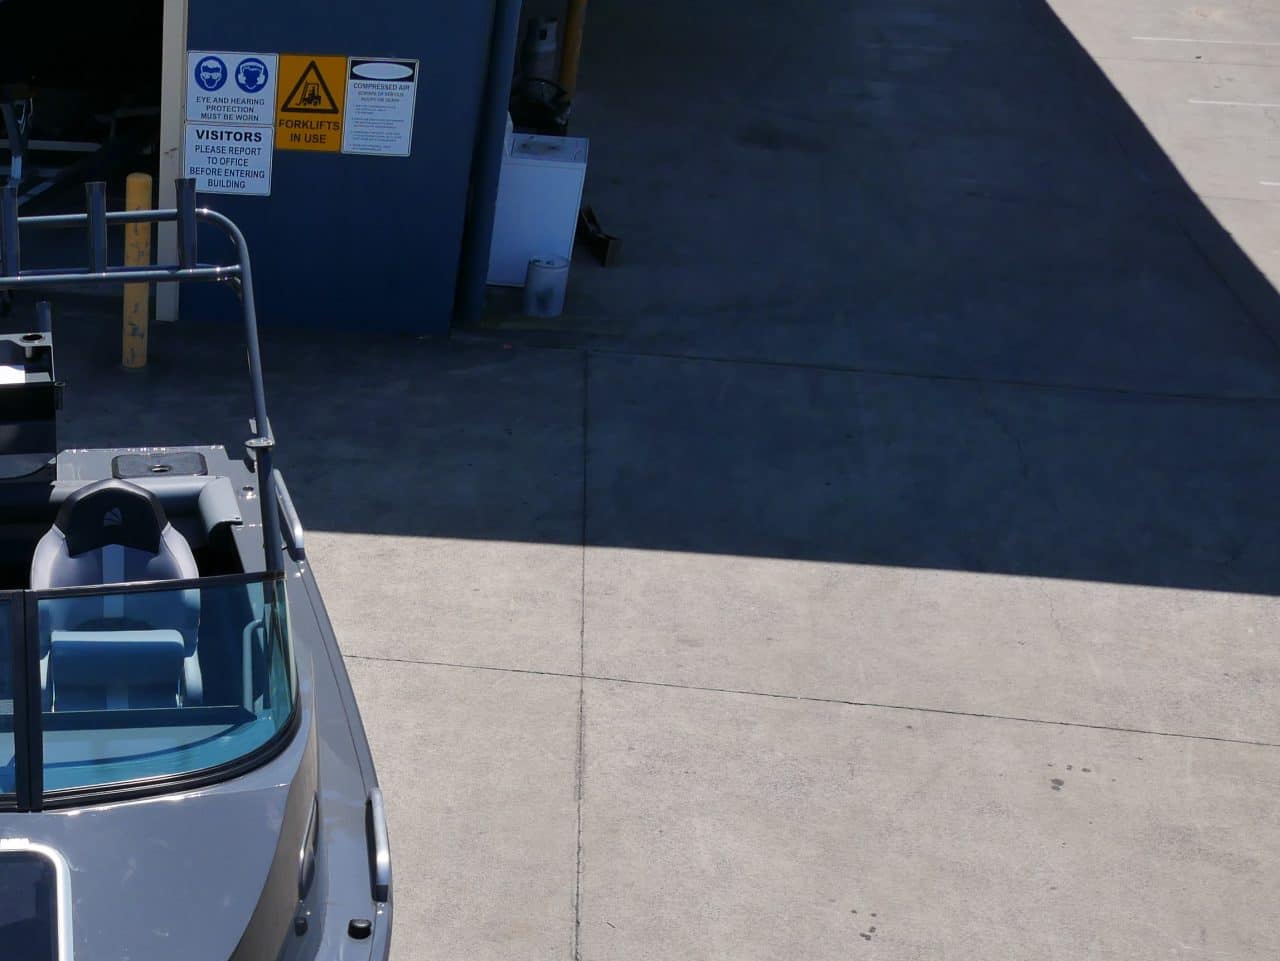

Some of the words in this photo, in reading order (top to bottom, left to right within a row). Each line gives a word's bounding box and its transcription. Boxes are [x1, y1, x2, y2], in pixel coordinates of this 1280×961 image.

[196, 95, 212, 104] EYE
[212, 96, 229, 104] AND
[231, 97, 265, 106] HEARING
[206, 105, 254, 113] PROTECTION
[200, 112, 222, 120] MUST
[224, 113, 234, 121] BE
[278, 119, 340, 131] FORKLIFTS
[195, 129, 262, 142] VISITORS
[290, 133, 301, 143] IN
[304, 133, 327, 144] USE
[195, 144, 227, 154] PLEASE
[228, 146, 262, 156] REPORT
[207, 156, 218, 165] TO
[220, 157, 249, 167] OFFICE
[189, 166, 223, 176] BEFORE
[224, 168, 265, 179] ENTERING
[207, 178, 246, 189] BUILDING
